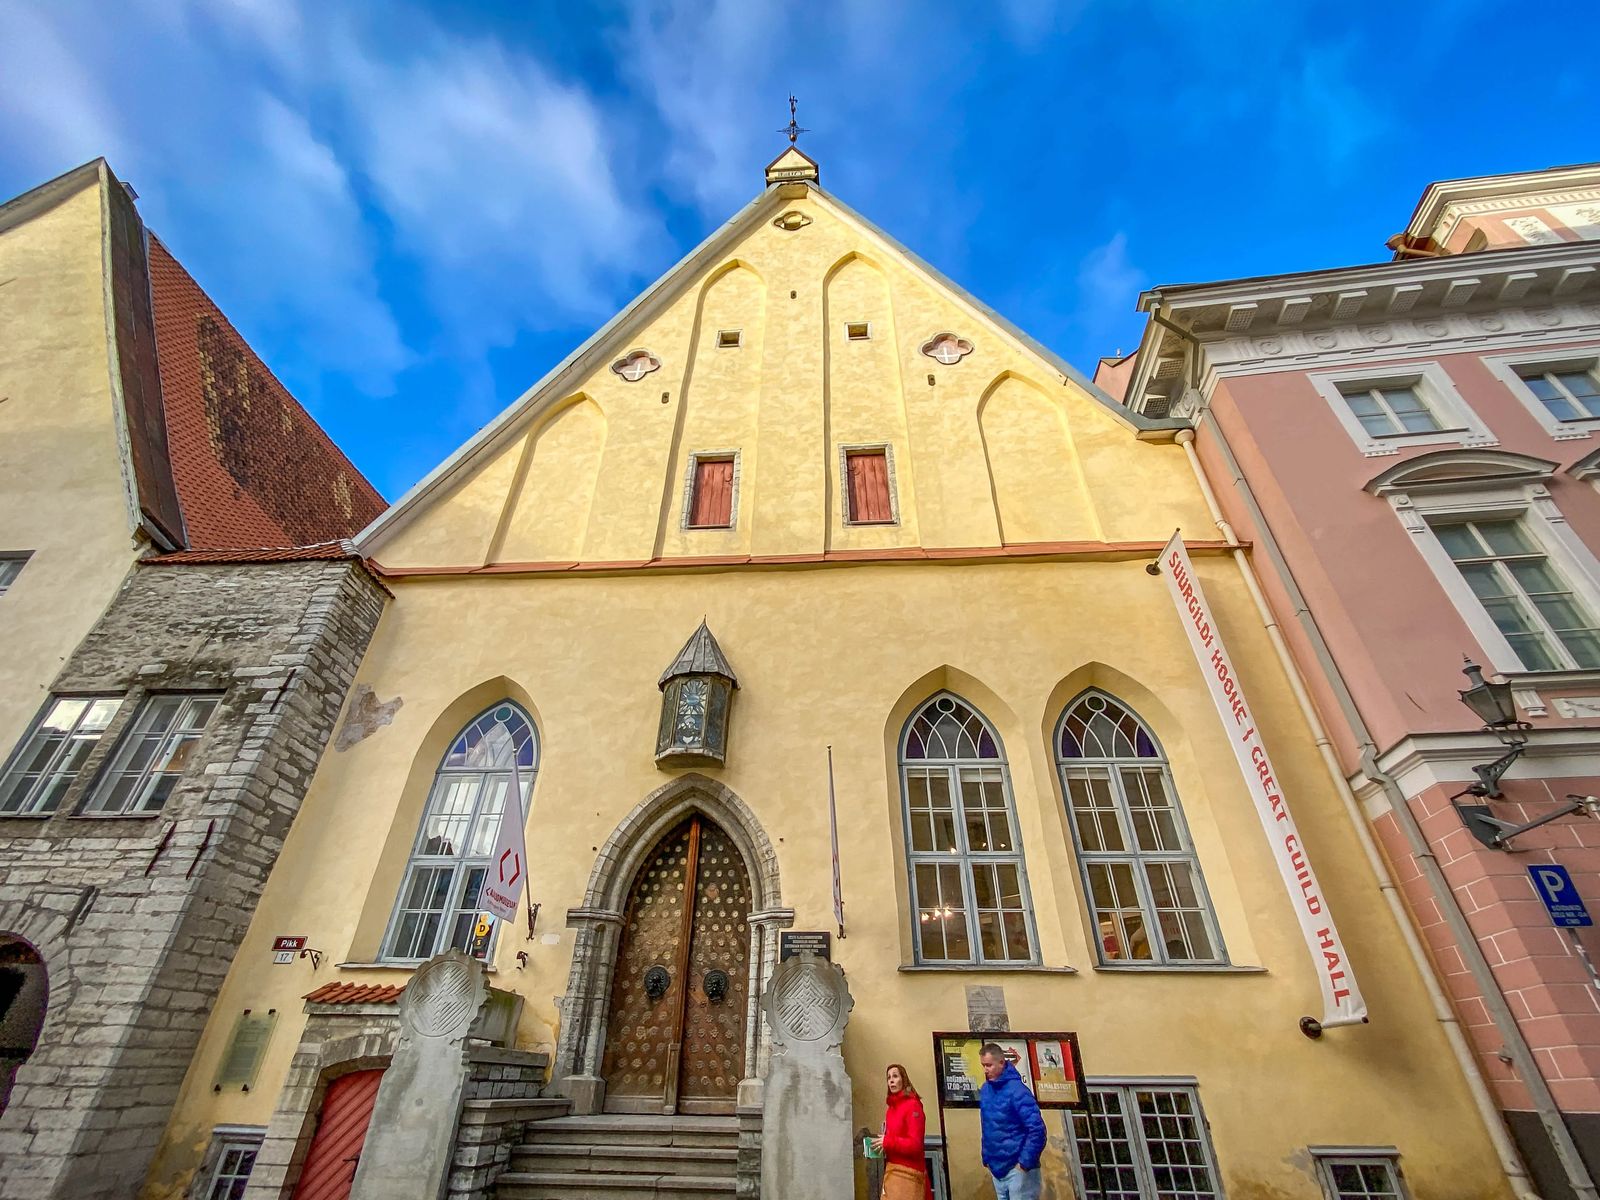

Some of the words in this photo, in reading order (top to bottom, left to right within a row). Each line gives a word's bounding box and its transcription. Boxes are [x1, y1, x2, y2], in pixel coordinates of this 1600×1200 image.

[1168, 551, 1214, 648] SUURGILDI
[1210, 649, 1248, 725] HOONE
[1251, 746, 1289, 822] GREAT
[1284, 834, 1321, 915] GUILD
[1316, 927, 1350, 1007] HALL
[1538, 870, 1565, 902] P
[281, 939, 298, 948] Pikk
[280, 953, 289, 961] 17
